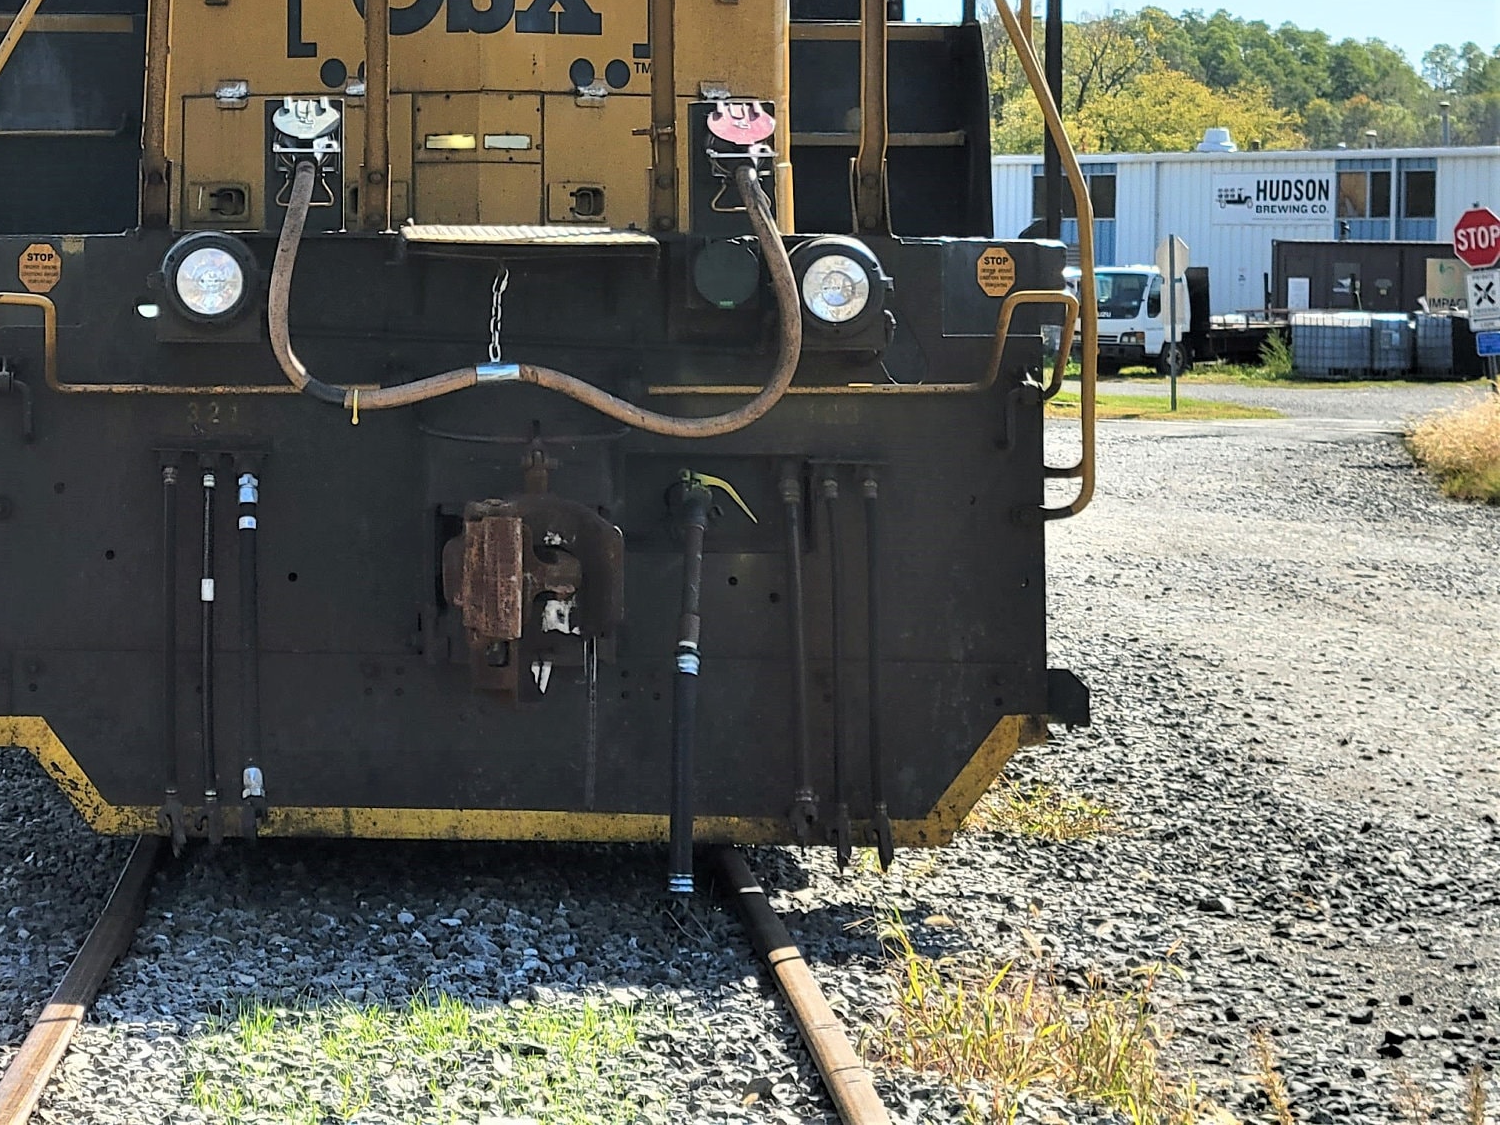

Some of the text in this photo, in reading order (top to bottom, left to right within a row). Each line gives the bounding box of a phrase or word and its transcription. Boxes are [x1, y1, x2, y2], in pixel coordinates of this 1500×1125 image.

[1255, 179, 1330, 201] HUDSON
[1255, 204, 1330, 214] BREWING CO.
[1456, 225, 1500, 252] STOP
[27, 252, 54, 262] STOP
[984, 256, 1009, 266] STOP
